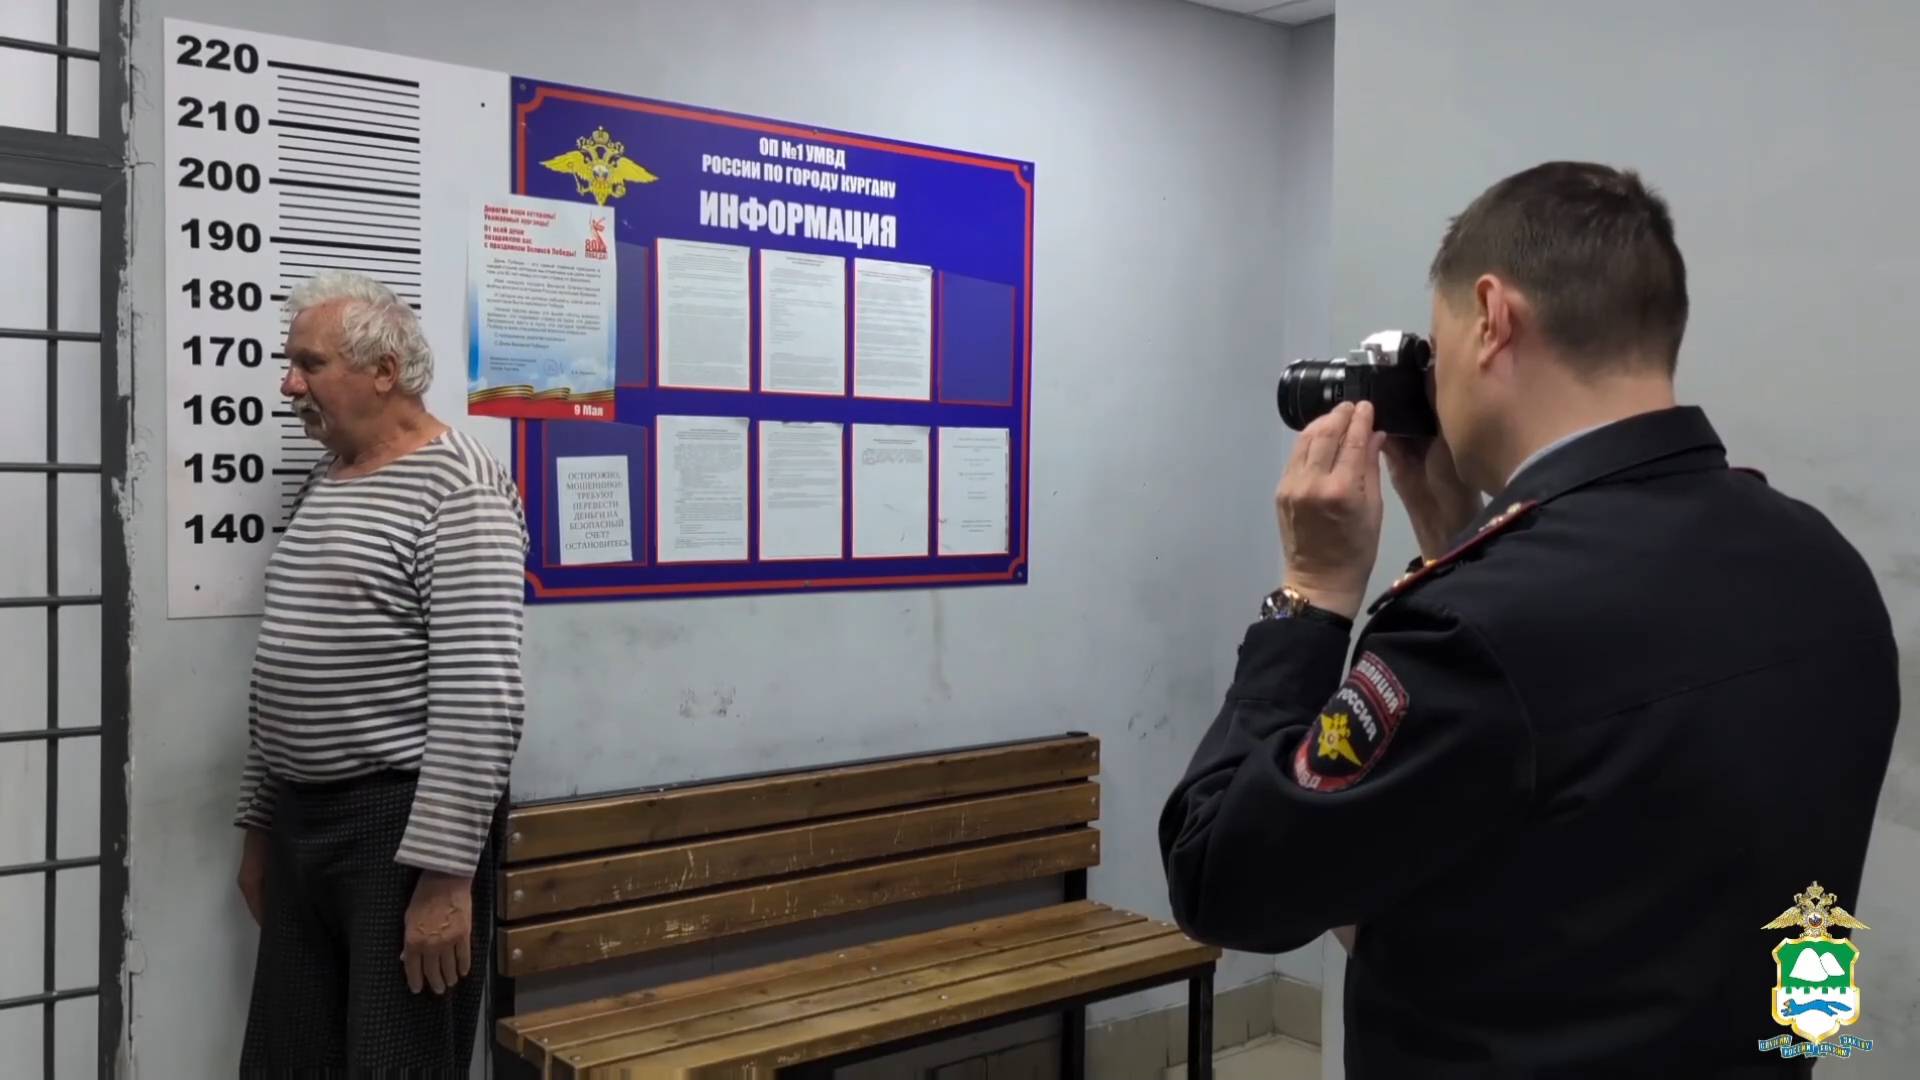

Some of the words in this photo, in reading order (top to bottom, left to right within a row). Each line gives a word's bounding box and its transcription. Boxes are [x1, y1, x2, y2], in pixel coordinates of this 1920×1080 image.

[177, 35, 259, 74] 220
[177, 96, 260, 134] 210
[759, 137, 779, 157] ОП
[781, 140, 803, 161] №1
[806, 144, 846, 170] УМВД
[178, 157, 261, 194] 200
[702, 154, 761, 180] РОССИИ
[763, 163, 783, 183] ПО
[785, 166, 838, 192] ГОРОДУ
[841, 175, 896, 199] КУРГАНУ
[181, 218, 261, 253] 190
[700, 190, 896, 249] ИНФОРМАЦИЯ
[182, 278, 262, 312] 180
[183, 335, 263, 368] 170
[183, 394, 263, 426] 160
[574, 404, 580, 415] 9
[583, 404, 603, 416] Мая
[184, 453, 264, 483] 150
[185, 513, 264, 544] 140
